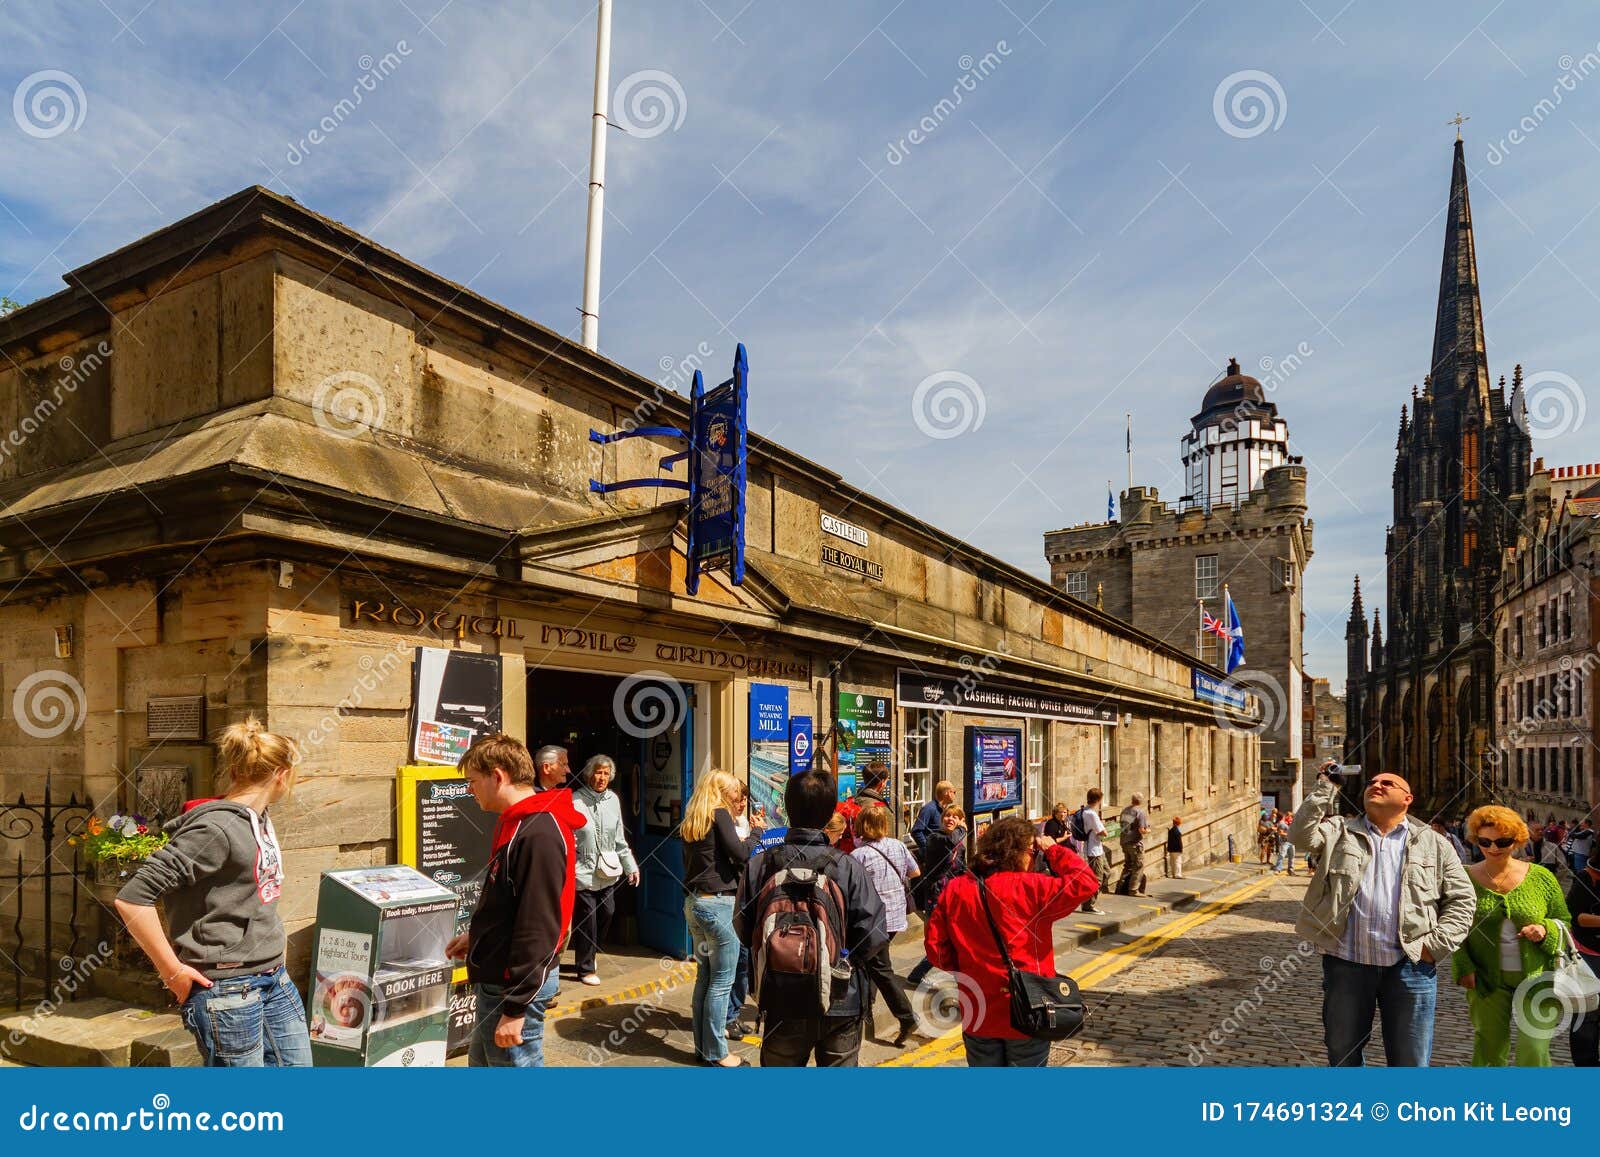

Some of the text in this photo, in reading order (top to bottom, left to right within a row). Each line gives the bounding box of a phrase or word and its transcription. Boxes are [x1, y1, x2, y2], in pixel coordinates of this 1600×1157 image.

[822, 516, 867, 544] CASTLEHILL
[823, 546, 882, 577] THE ROYAL MILE
[759, 703, 782, 711] TARTAN
[964, 689, 1004, 705] CASHMERE
[1008, 695, 1037, 709] FACTORY
[1040, 700, 1061, 712] OUTLET
[759, 719, 783, 731] MILL
[440, 733, 464, 742] ABOUT
[857, 730, 890, 739] BOOK HERE
[386, 908, 400, 917] Book
[418, 904, 432, 913] travel
[345, 939, 357, 948] day
[320, 947, 368, 962] Highland Tours
[385, 971, 443, 996] BOOK HERE
